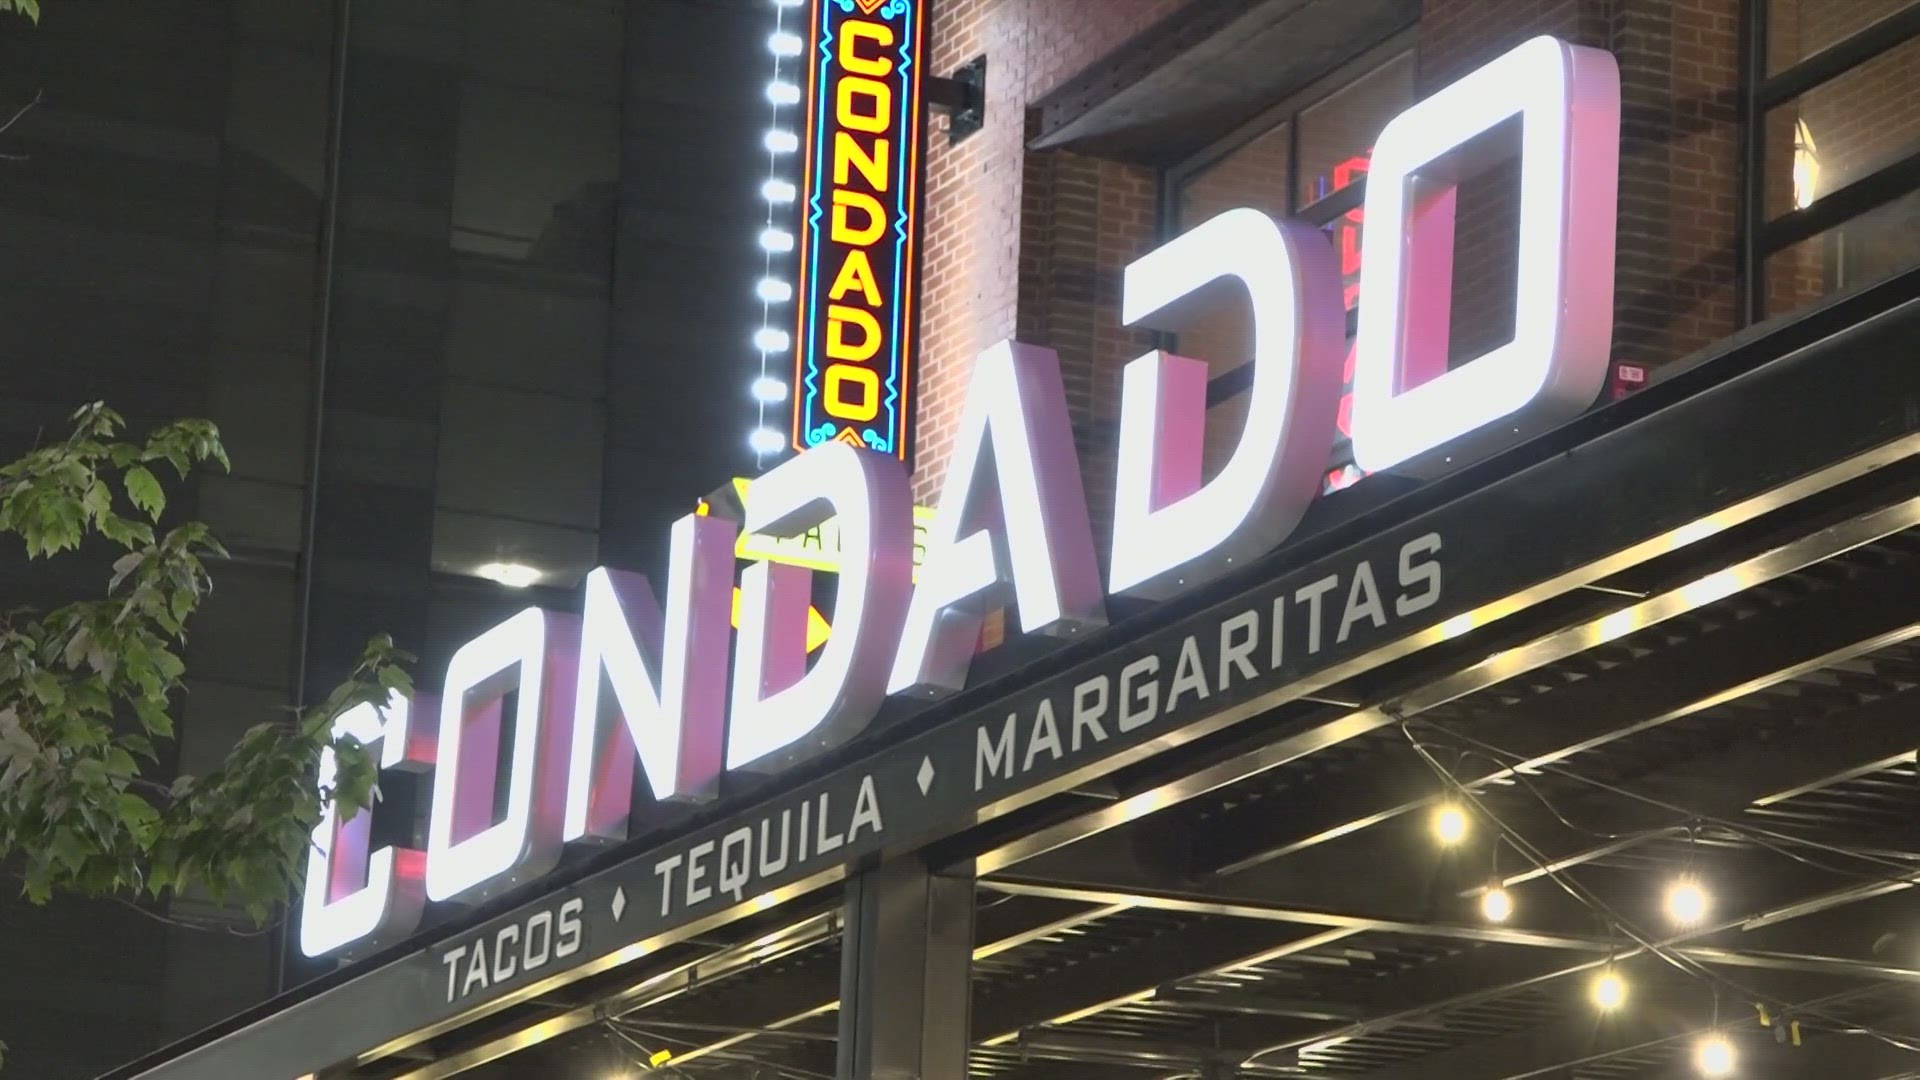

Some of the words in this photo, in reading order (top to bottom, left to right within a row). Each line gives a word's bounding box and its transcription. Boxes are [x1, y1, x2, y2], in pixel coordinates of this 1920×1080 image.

[823, 19, 894, 422] CONDADO
[299, 35, 1574, 958] CONDADO
[443, 897, 583, 1003] TACOS
[654, 775, 883, 917] TEQUILA
[974, 531, 1442, 792] MARGARITAS
